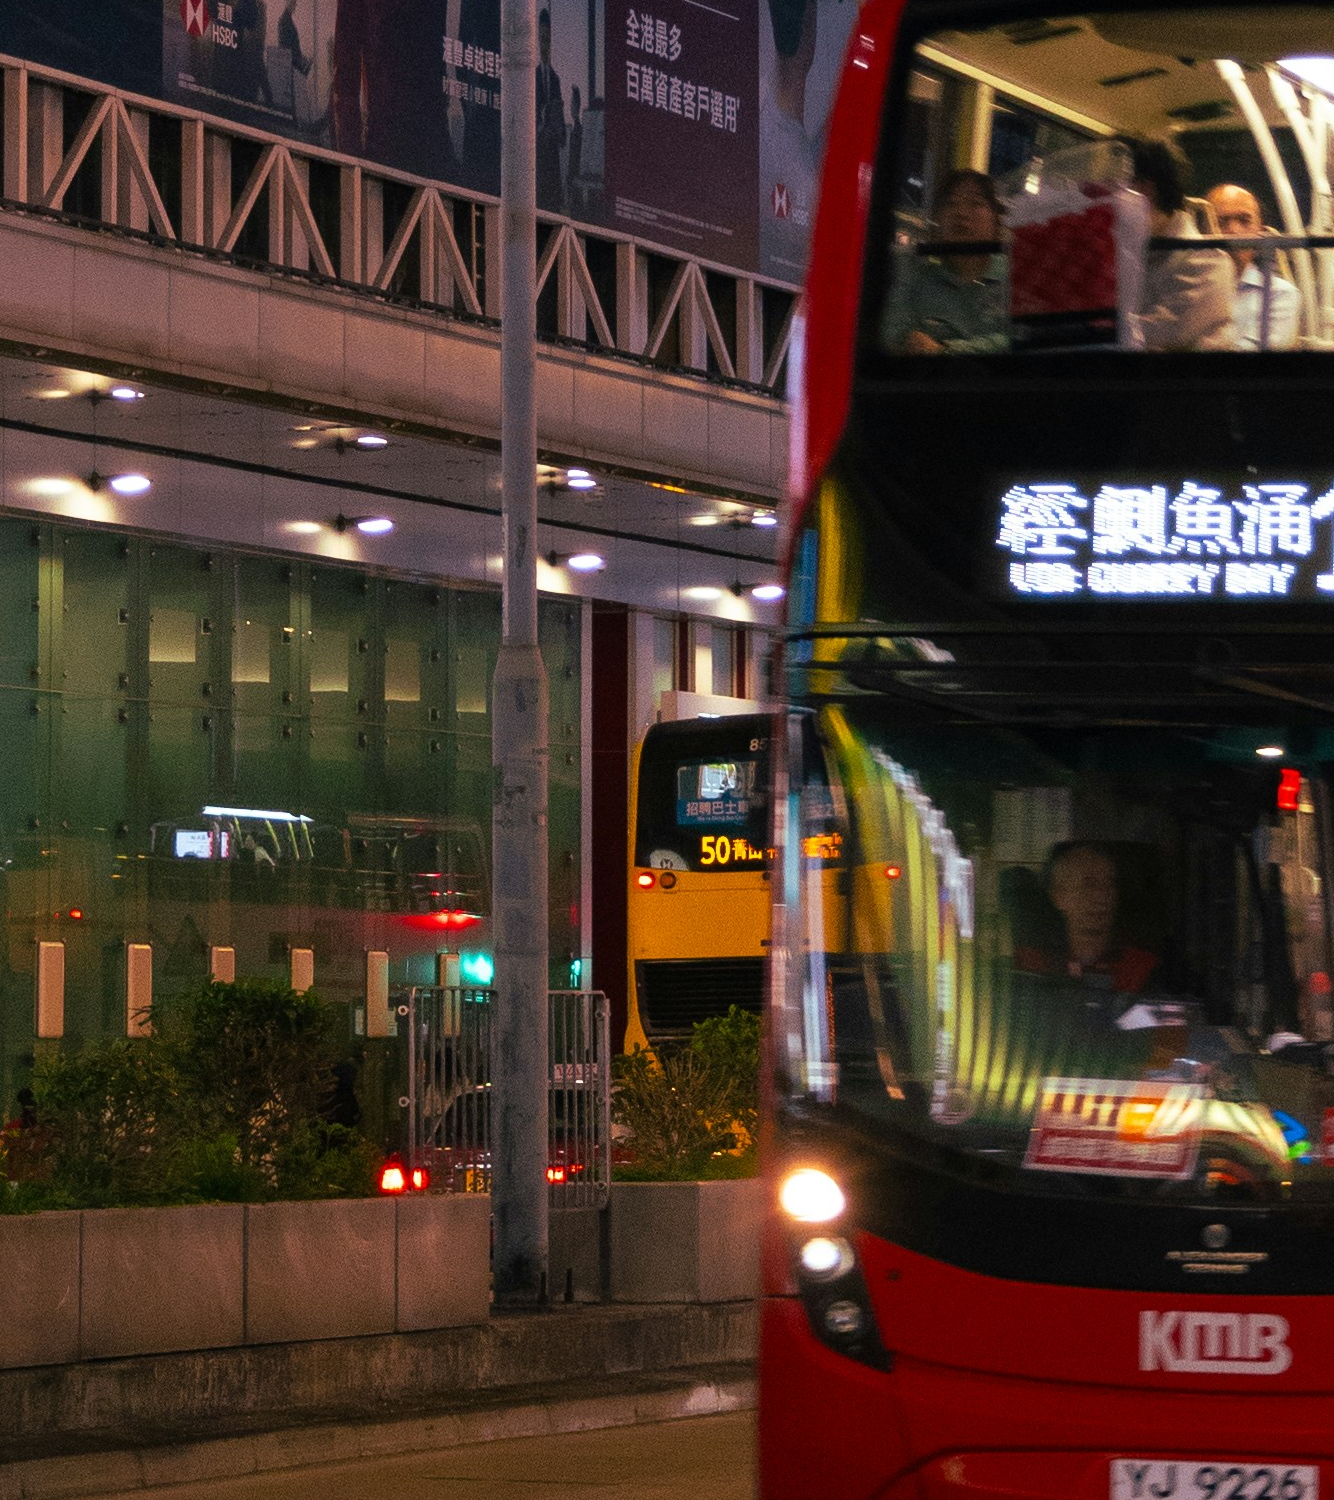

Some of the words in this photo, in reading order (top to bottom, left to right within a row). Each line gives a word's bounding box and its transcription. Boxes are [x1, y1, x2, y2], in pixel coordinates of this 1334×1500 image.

[211, 24, 239, 50] HSBC
[624, 8, 683, 63] 全港最多
[699, 835, 731, 866] 50
[1137, 1309, 1295, 1376] KMB
